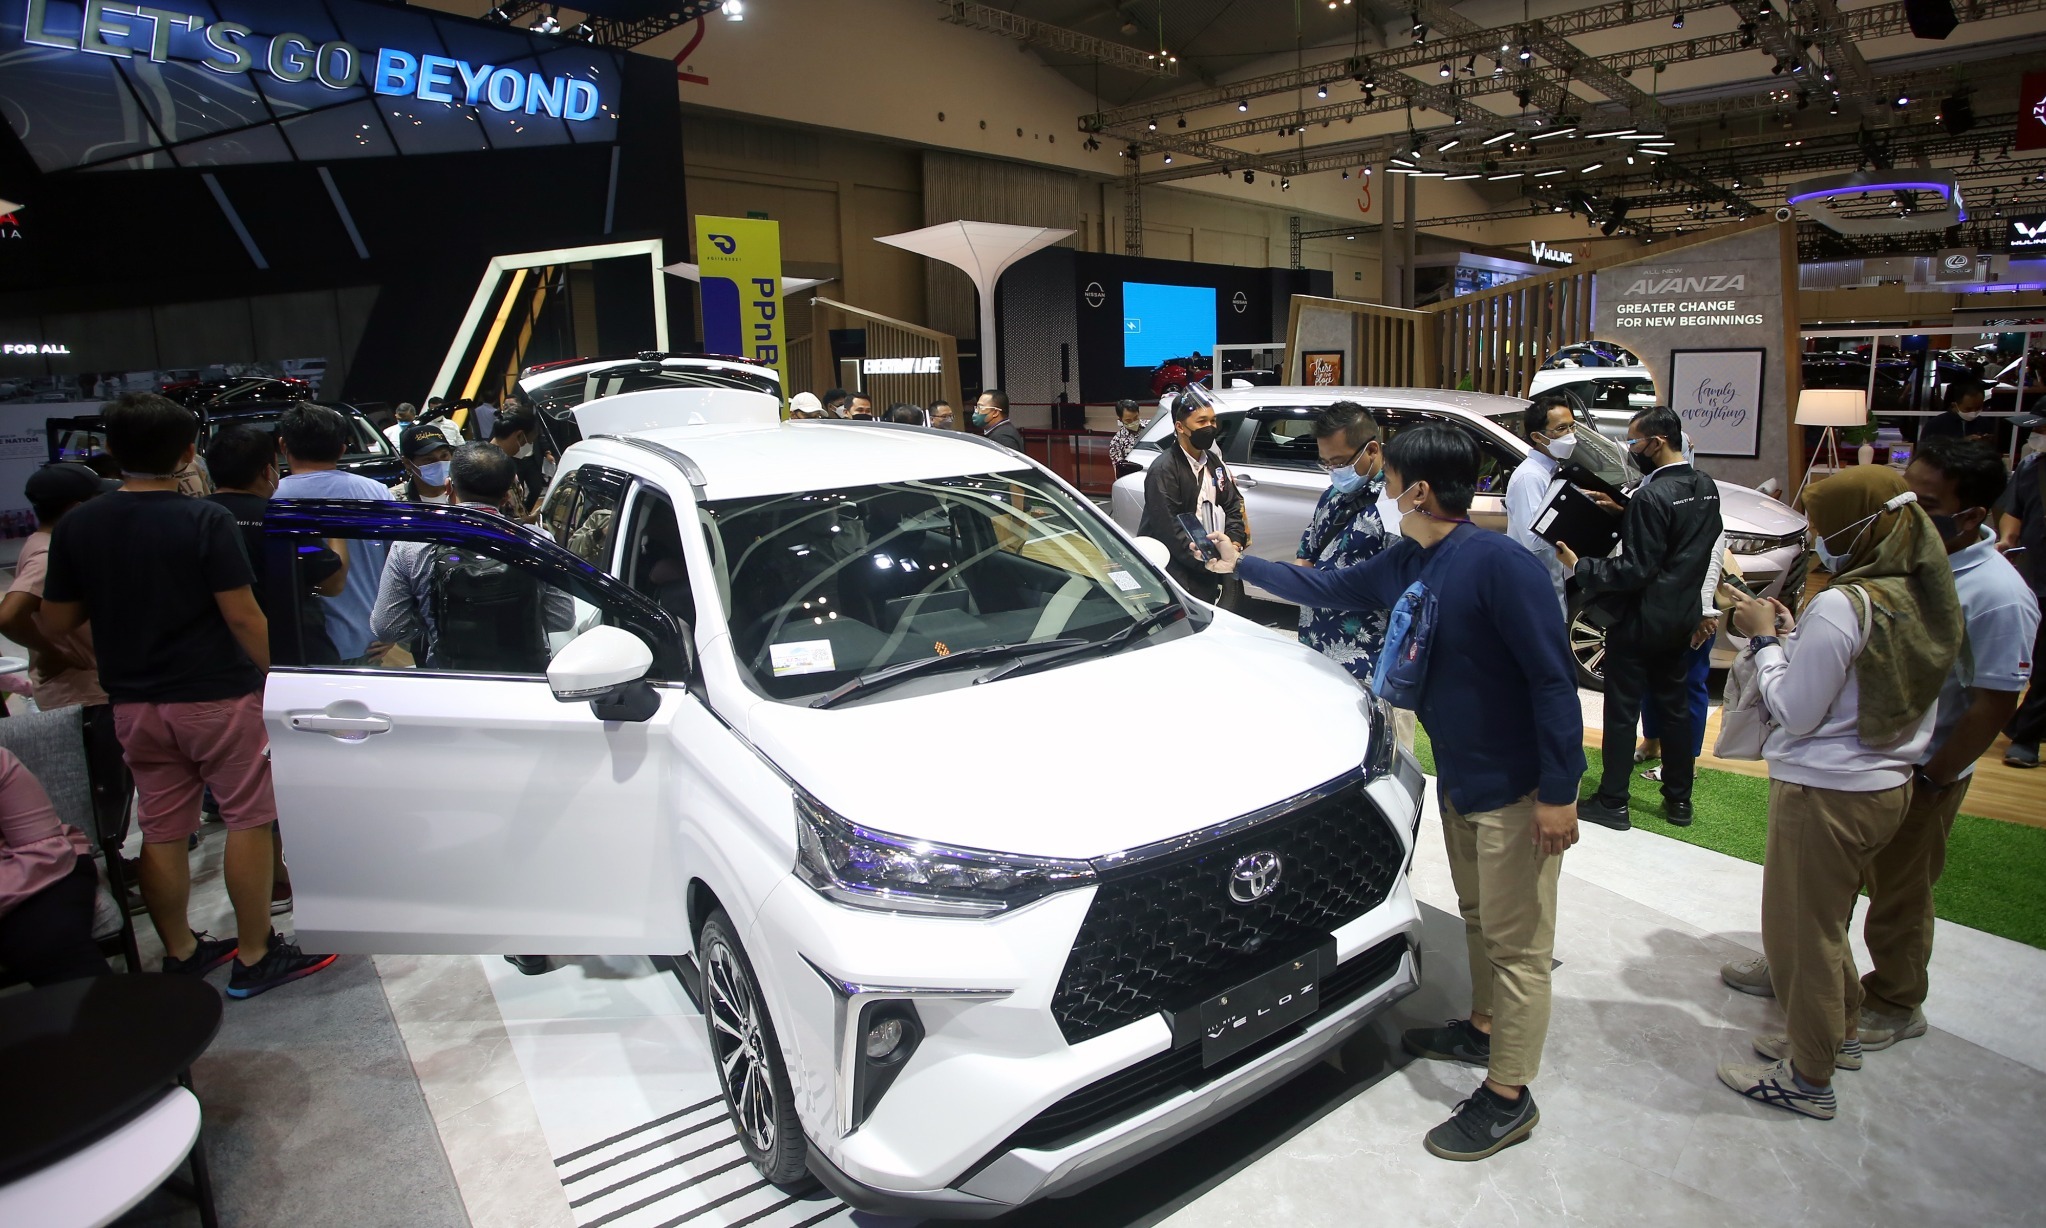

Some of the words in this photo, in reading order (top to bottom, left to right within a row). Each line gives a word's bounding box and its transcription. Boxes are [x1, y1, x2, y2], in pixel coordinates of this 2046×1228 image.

[24, 0, 253, 74] LET'S
[267, 32, 360, 90] GO
[374, 47, 600, 121] BEYOND
[1544, 248, 1573, 264] WULING
[1623, 274, 1745, 296] AVANZA
[1616, 302, 1675, 314] GREATER
[1679, 301, 1736, 312] CHANGE
[752, 277, 779, 368] PPnB
[1616, 317, 1642, 328] FOR
[1645, 316, 1677, 327] NEW
[1679, 314, 1763, 326] BEGINNINGS
[4, 344, 38, 354] FOR
[41, 344, 70, 354] ALL
[1692, 378, 1741, 404] family
[1708, 398, 1718, 407] is
[1681, 406, 1748, 428] everything
[1208, 983, 1314, 1038] VELOZ
